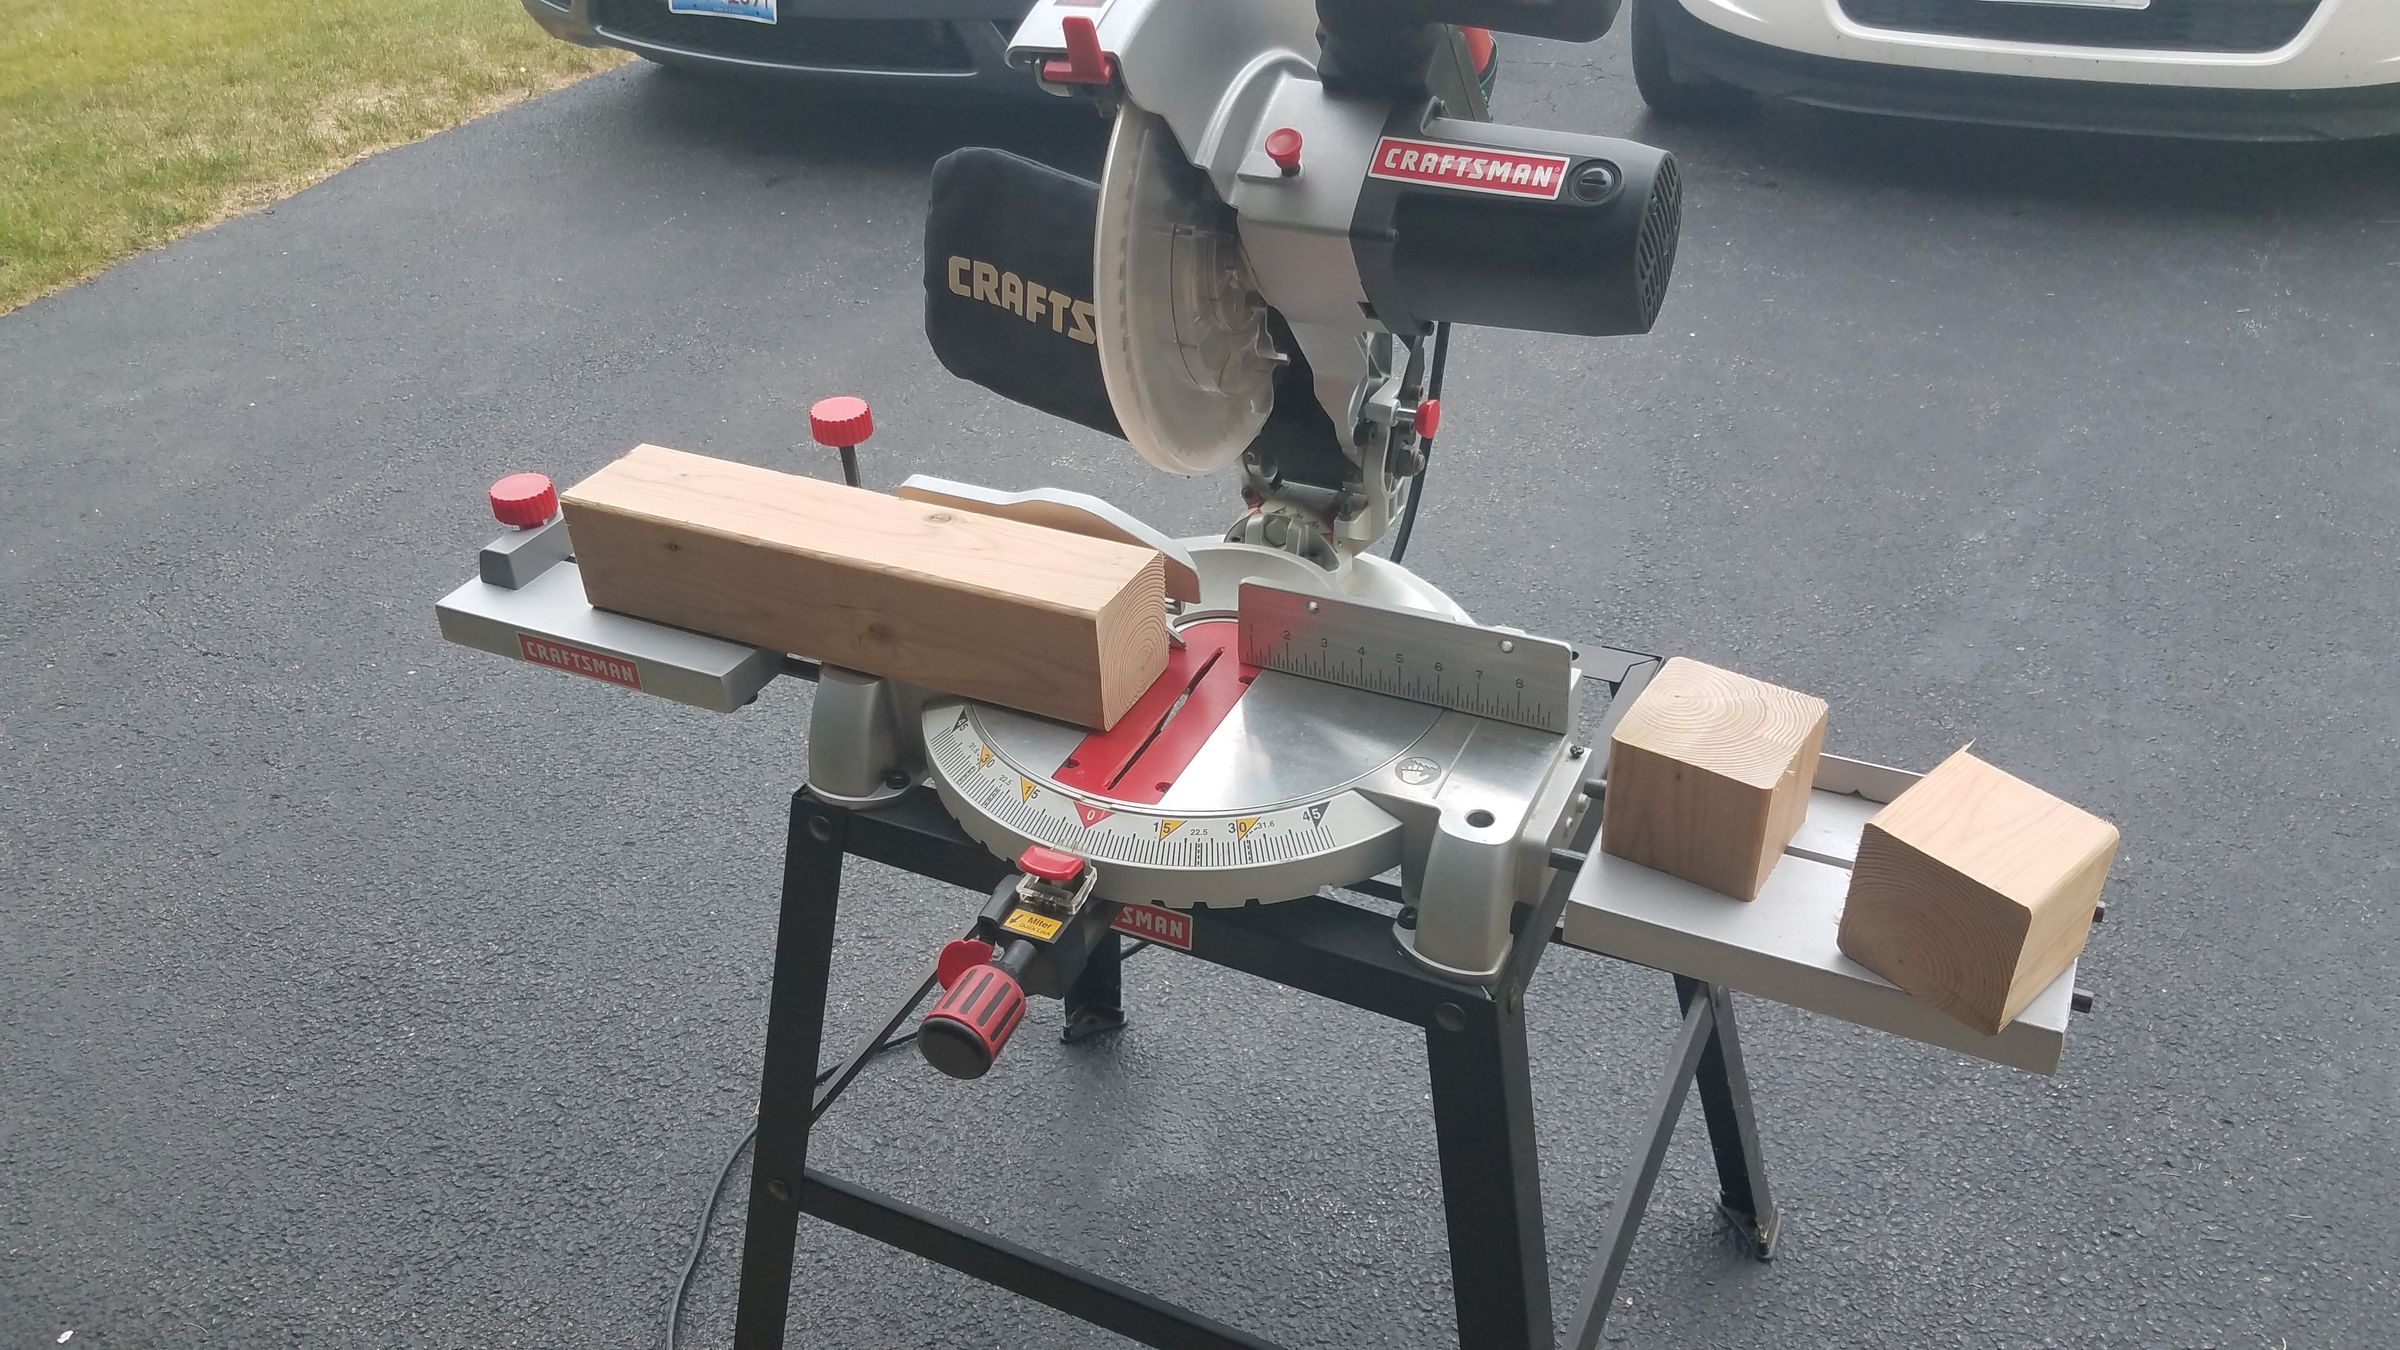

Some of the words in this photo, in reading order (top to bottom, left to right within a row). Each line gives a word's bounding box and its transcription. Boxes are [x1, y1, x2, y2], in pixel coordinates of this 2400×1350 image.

[1384, 148, 1554, 188] CRAFTSMAN
[526, 640, 635, 682] CRAFTSMAN
[1283, 630, 1291, 640] 2
[1321, 638, 1328, 648] 3
[1358, 646, 1366, 656] 4
[1396, 653, 1404, 664] 5
[1434, 662, 1443, 672] 6
[1475, 670, 1483, 681] 7
[1515, 678, 1524, 689] 8
[981, 753, 996, 769] 30
[1024, 785, 1040, 799] 15
[1086, 809, 1096, 821] 0
[1302, 808, 1321, 822] 45
[1153, 822, 1171, 834] 15
[1190, 828, 1208, 836] 22.5
[1227, 822, 1247, 834] 30
[1257, 820, 1275, 830] 31.6
[1027, 916, 1053, 929] Miter
[1115, 906, 1183, 939] SMAN
